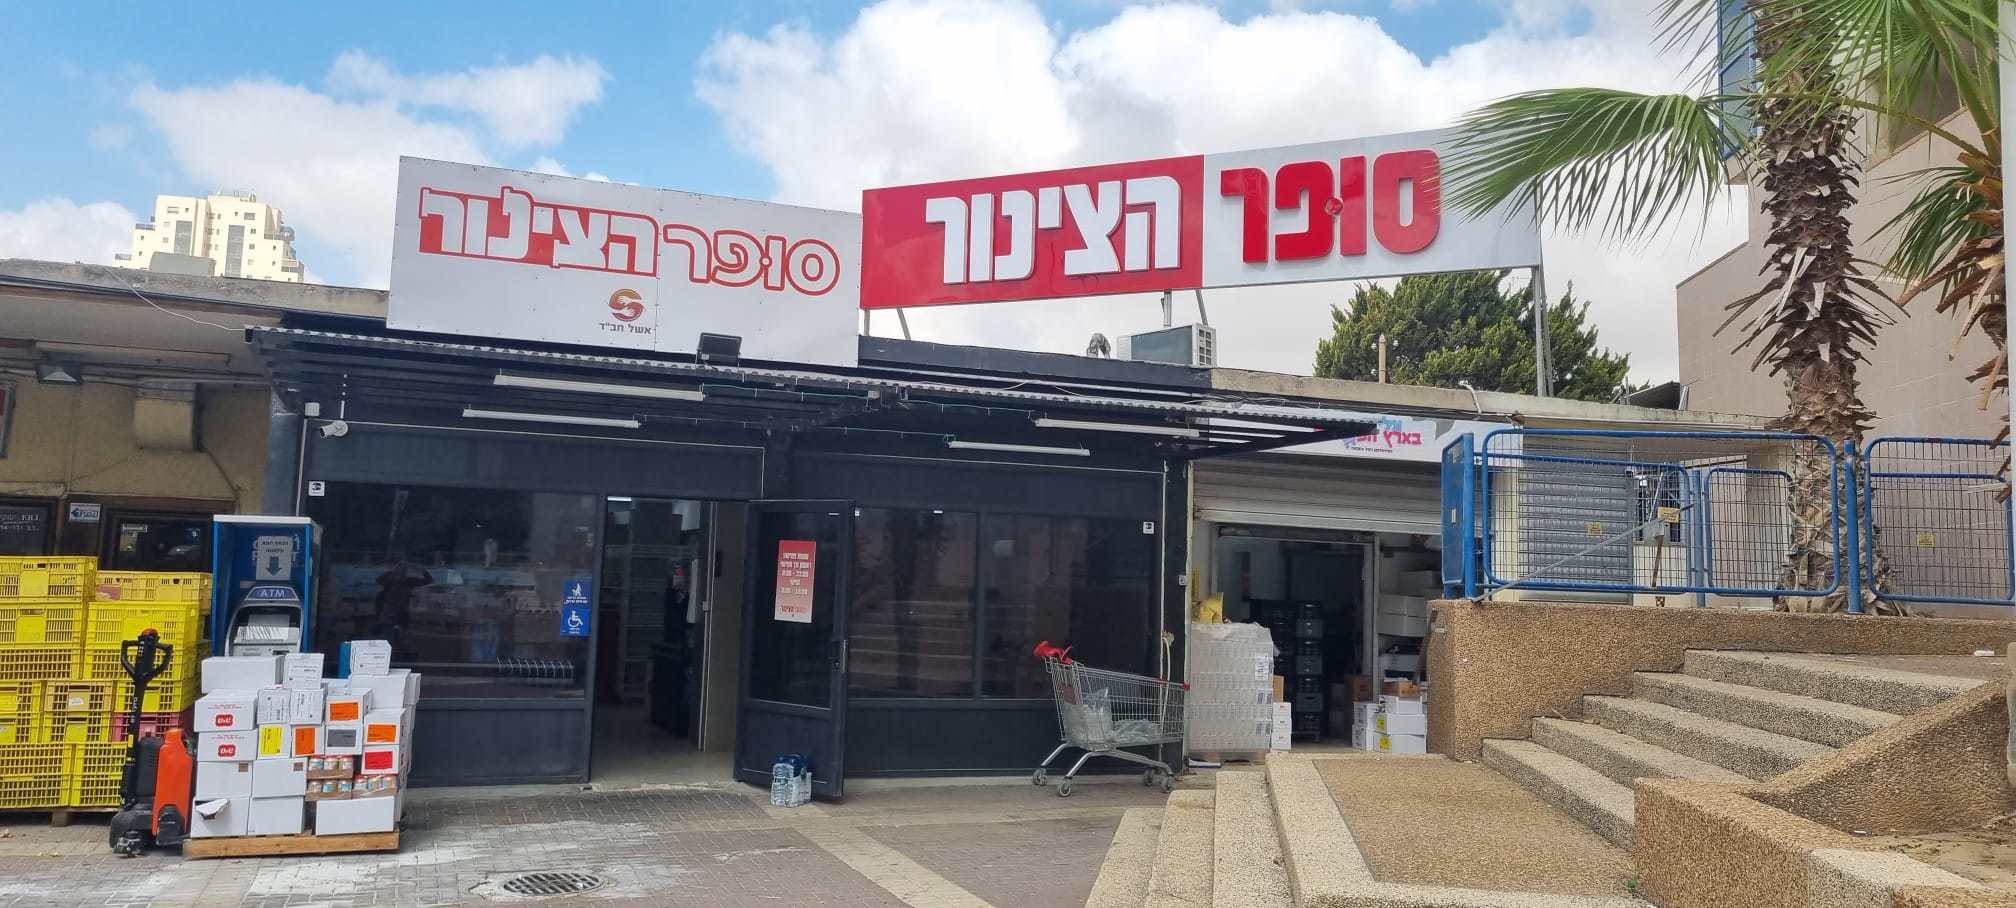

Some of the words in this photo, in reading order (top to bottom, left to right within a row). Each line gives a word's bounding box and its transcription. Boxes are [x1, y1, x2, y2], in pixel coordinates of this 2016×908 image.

[1219, 148, 1442, 265] סופר
[418, 185, 658, 276] הצינור
[925, 176, 1183, 285] הצינור
[663, 223, 840, 296] סופר
[599, 321, 625, 333] חב"ד
[627, 324, 652, 335] אשל
[1383, 430, 1423, 449] בארץ
[261, 589, 285, 598] ATM
